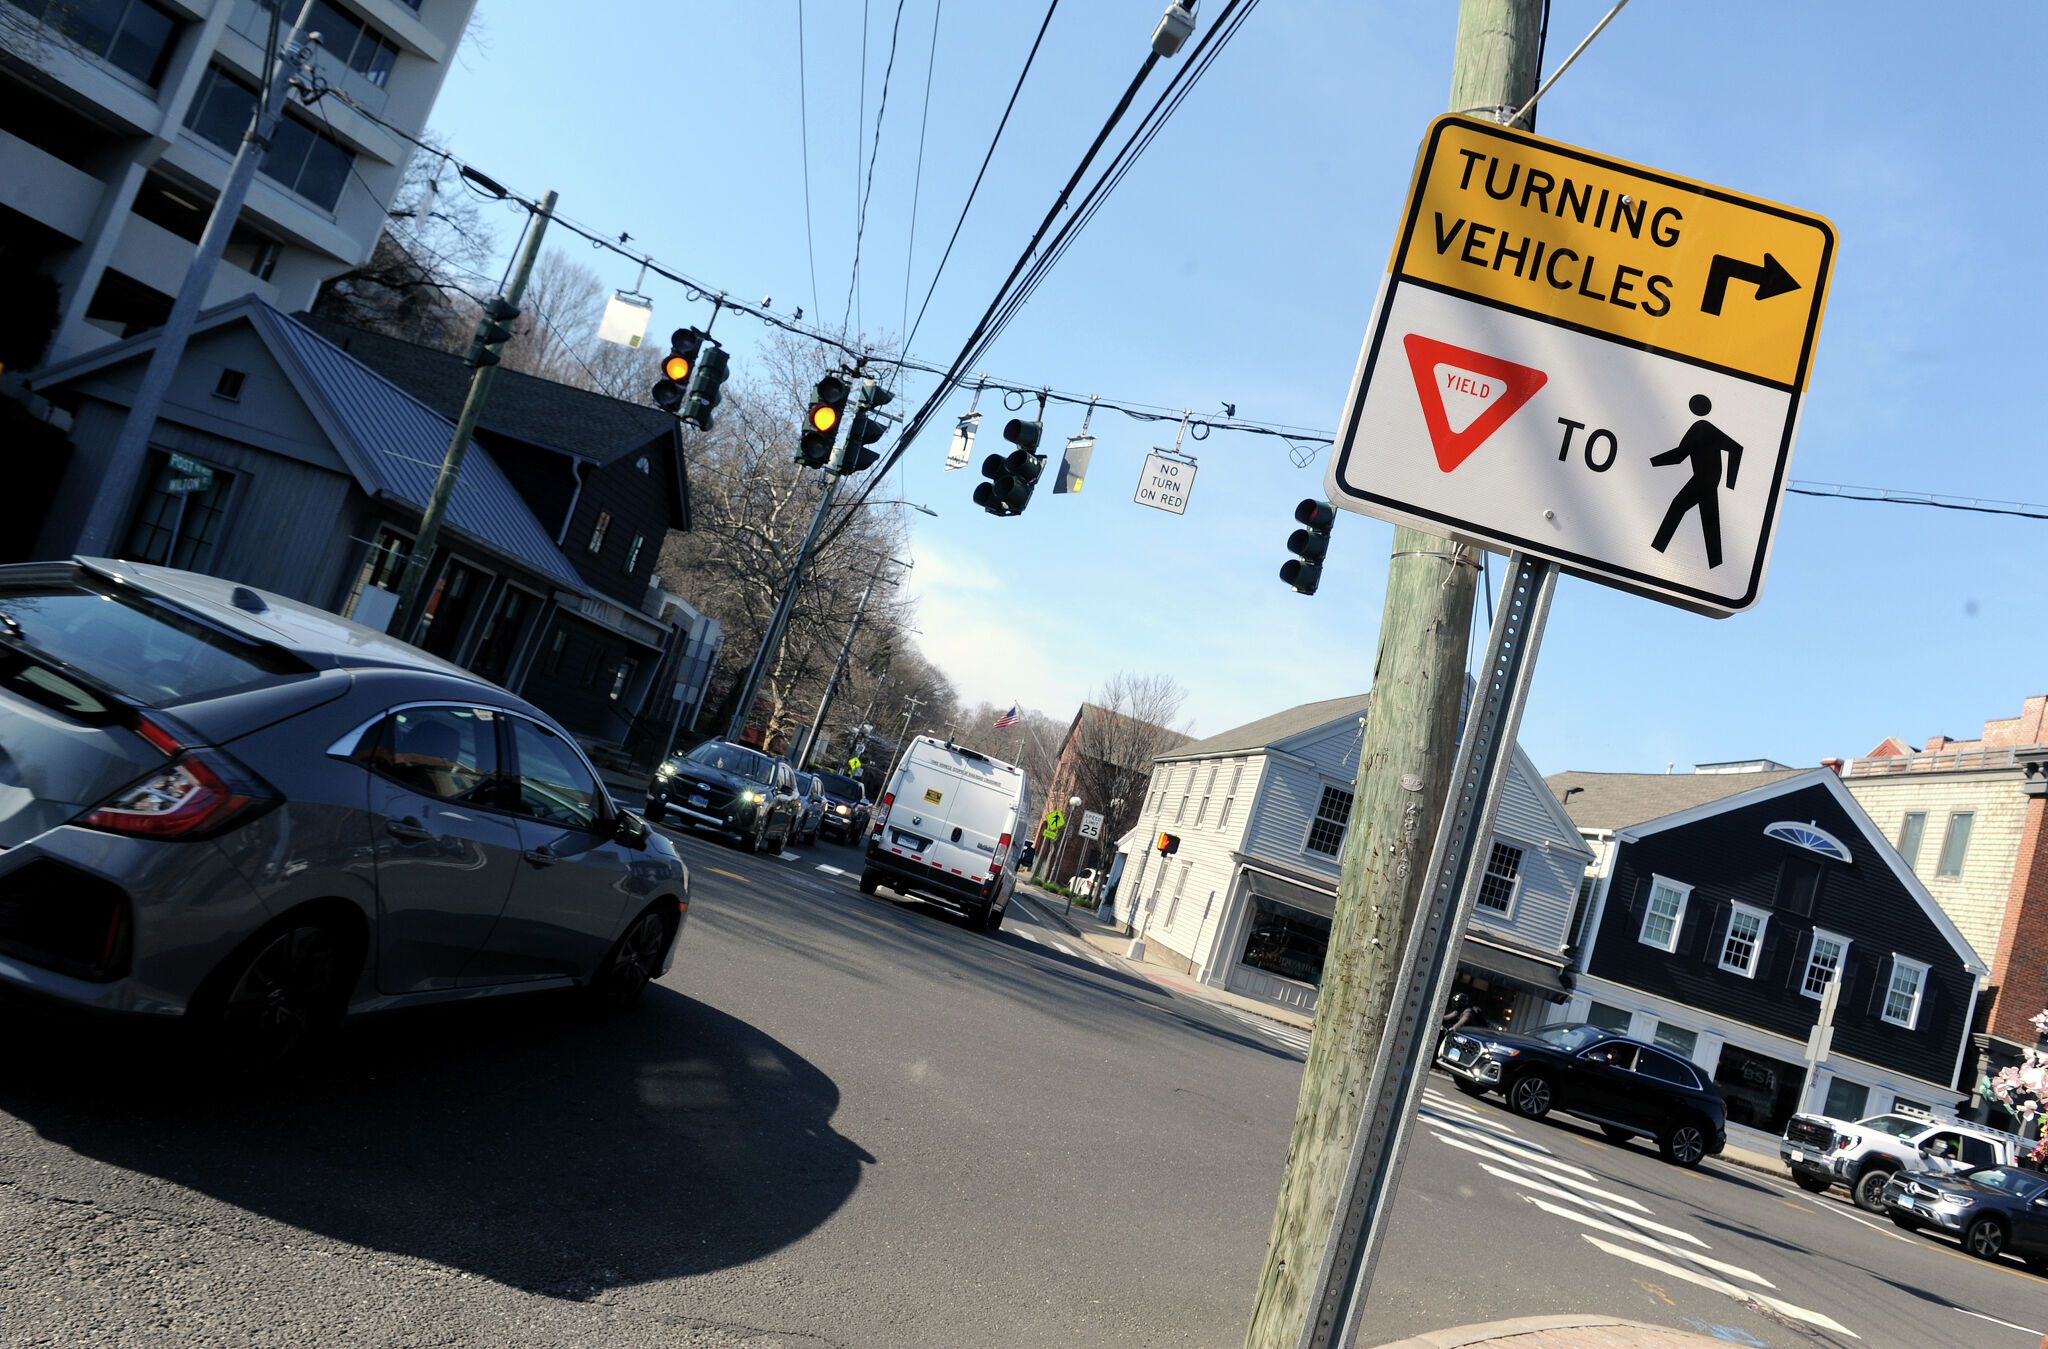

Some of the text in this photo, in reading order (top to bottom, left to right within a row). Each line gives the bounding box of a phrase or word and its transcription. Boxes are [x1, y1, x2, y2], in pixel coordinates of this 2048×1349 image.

[1459, 149, 1684, 248] TURNING
[1434, 212, 1674, 318] VEHICLES
[1447, 374, 1490, 399] YIELD
[1557, 417, 1618, 473] TO
[171, 453, 194, 473] POST
[1160, 464, 1178, 476] NO
[1152, 476, 1180, 492] TURN
[1141, 489, 1182, 507] ON RED
[1085, 813, 1102, 823] SPEED
[1085, 819, 1099, 827] LIMIT
[1081, 824, 1098, 837] 25
